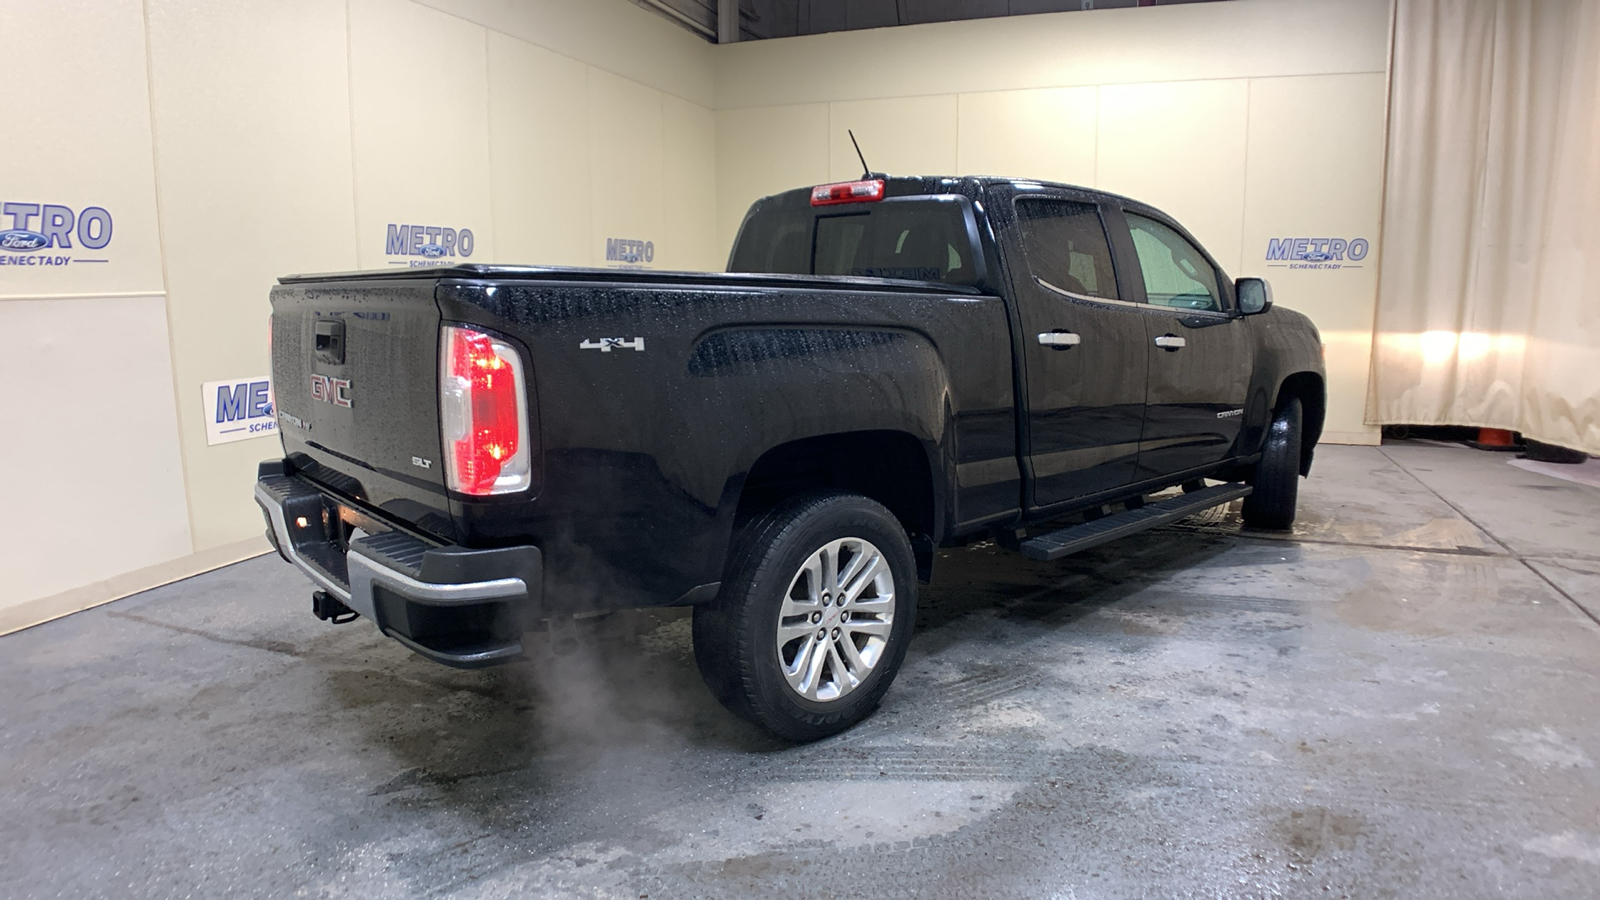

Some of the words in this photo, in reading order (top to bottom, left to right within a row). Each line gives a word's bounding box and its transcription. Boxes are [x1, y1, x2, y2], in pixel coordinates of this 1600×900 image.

[0, 202, 113, 250] TRO
[1, 233, 40, 248] Ford
[385, 223, 474, 257] METRO
[606, 237, 655, 263] METRO
[1265, 238, 1369, 261] METRO
[216, 381, 269, 424] ME
[310, 374, 353, 408] GMC
[249, 421, 279, 433] SCHEN
[411, 456, 432, 469] SLT
